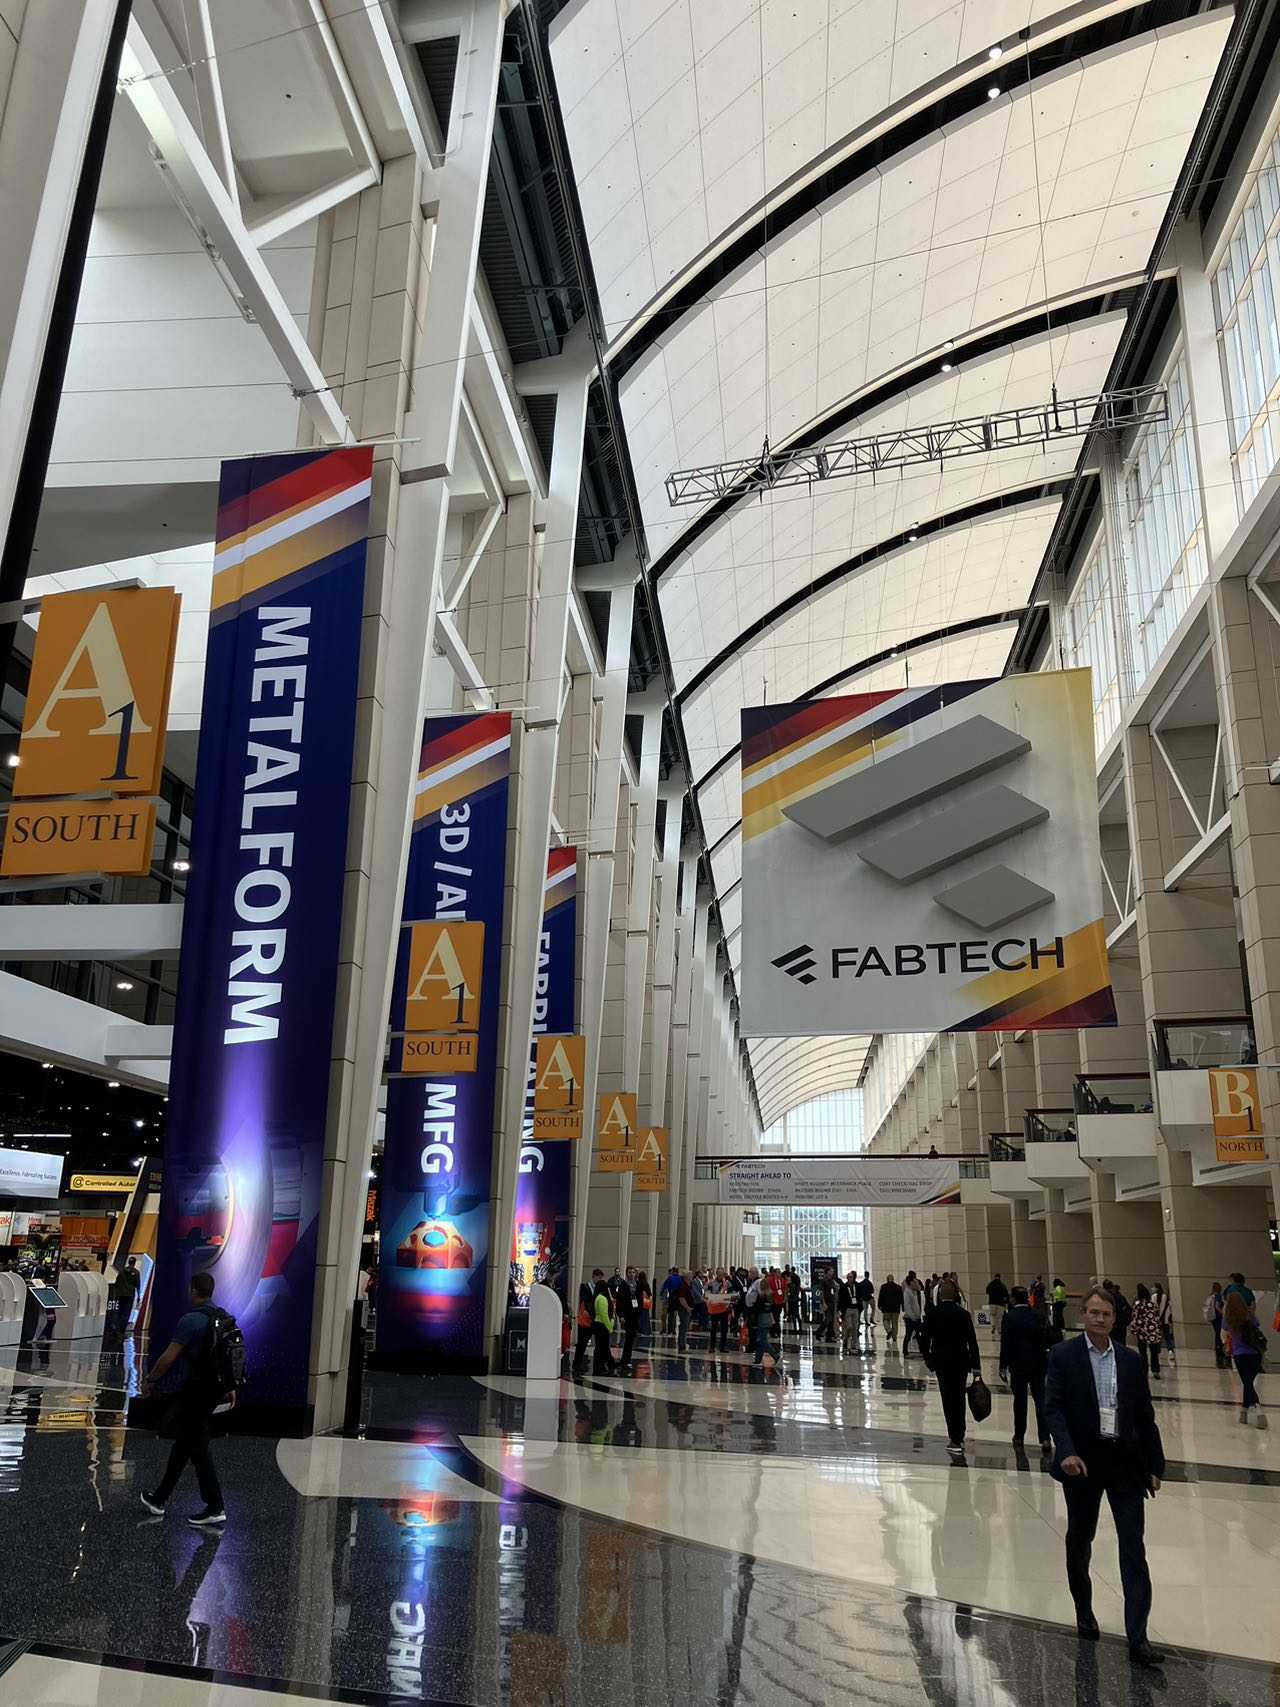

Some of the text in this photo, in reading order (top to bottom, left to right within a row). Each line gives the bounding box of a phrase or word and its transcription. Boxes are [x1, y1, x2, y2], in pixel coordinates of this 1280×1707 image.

[12, 813, 140, 843] SOUTH
[224, 606, 312, 1045] METALFORM
[440, 802, 471, 853] 3D
[831, 936, 1065, 979] FABTECH
[406, 1040, 472, 1056] SOUTH
[421, 1083, 457, 1174] MFG
[535, 1116, 580, 1128] SOUTH
[600, 1152, 633, 1162] SOUTH
[1219, 1142, 1264, 1152] NORTH
